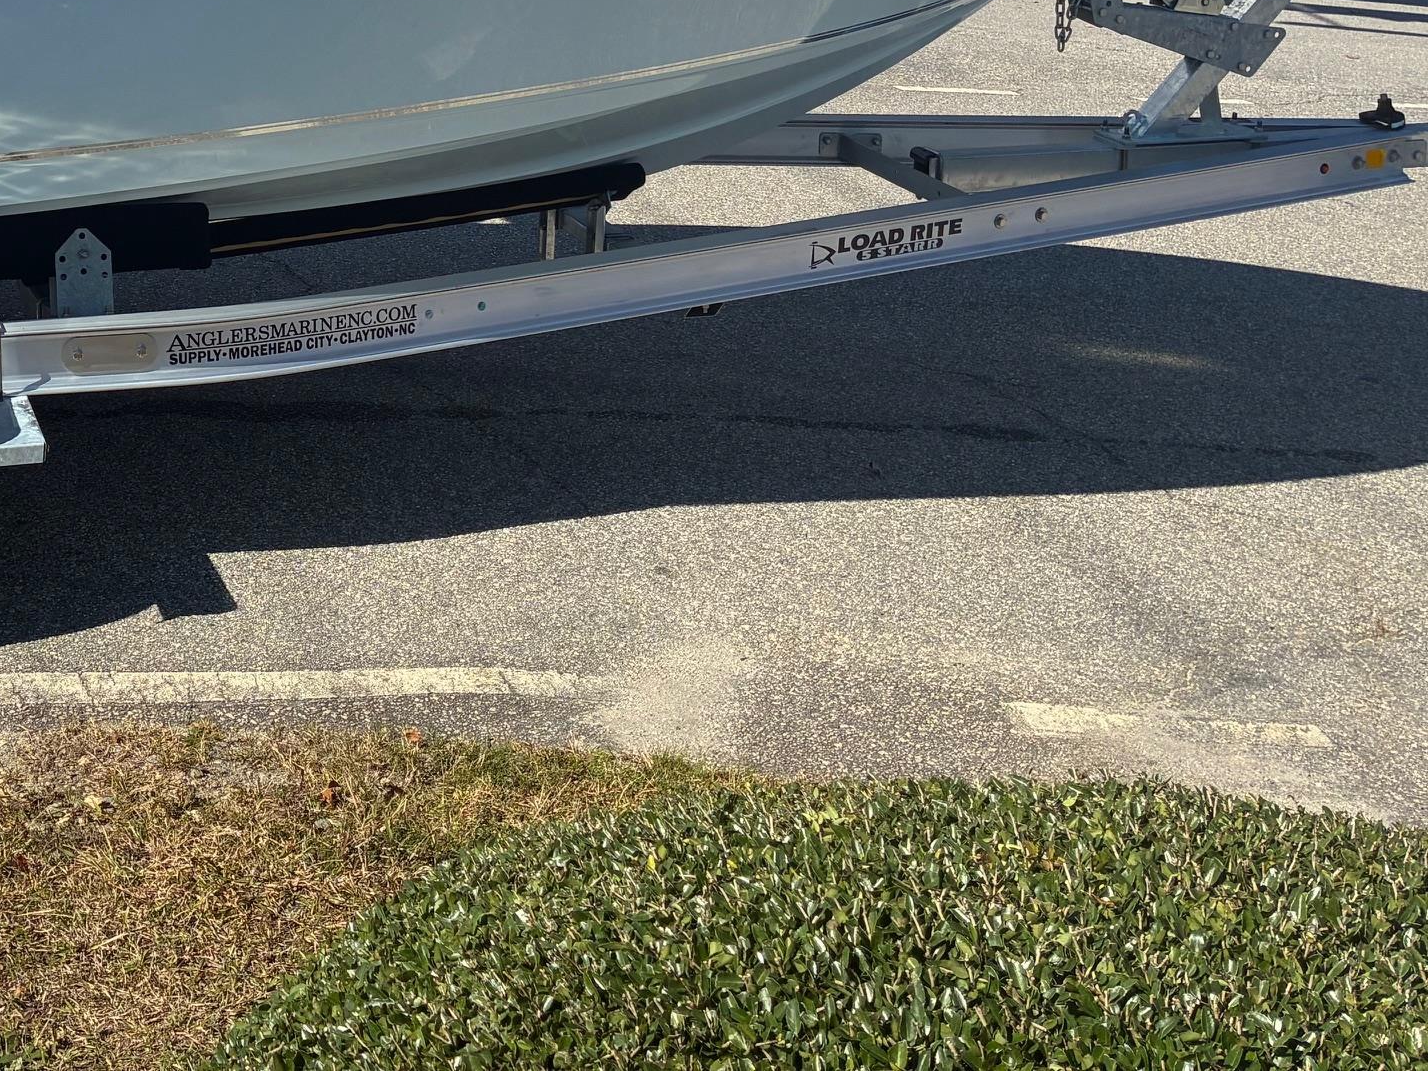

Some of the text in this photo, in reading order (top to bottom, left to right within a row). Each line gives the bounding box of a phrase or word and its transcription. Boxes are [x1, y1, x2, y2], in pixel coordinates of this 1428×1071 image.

[837, 218, 963, 254] LOAD RITE
[166, 303, 418, 353] ANGLERSMARINENC.COM
[169, 322, 417, 366] SUPPLY MOREHEAD CITY CLAYTON NC
